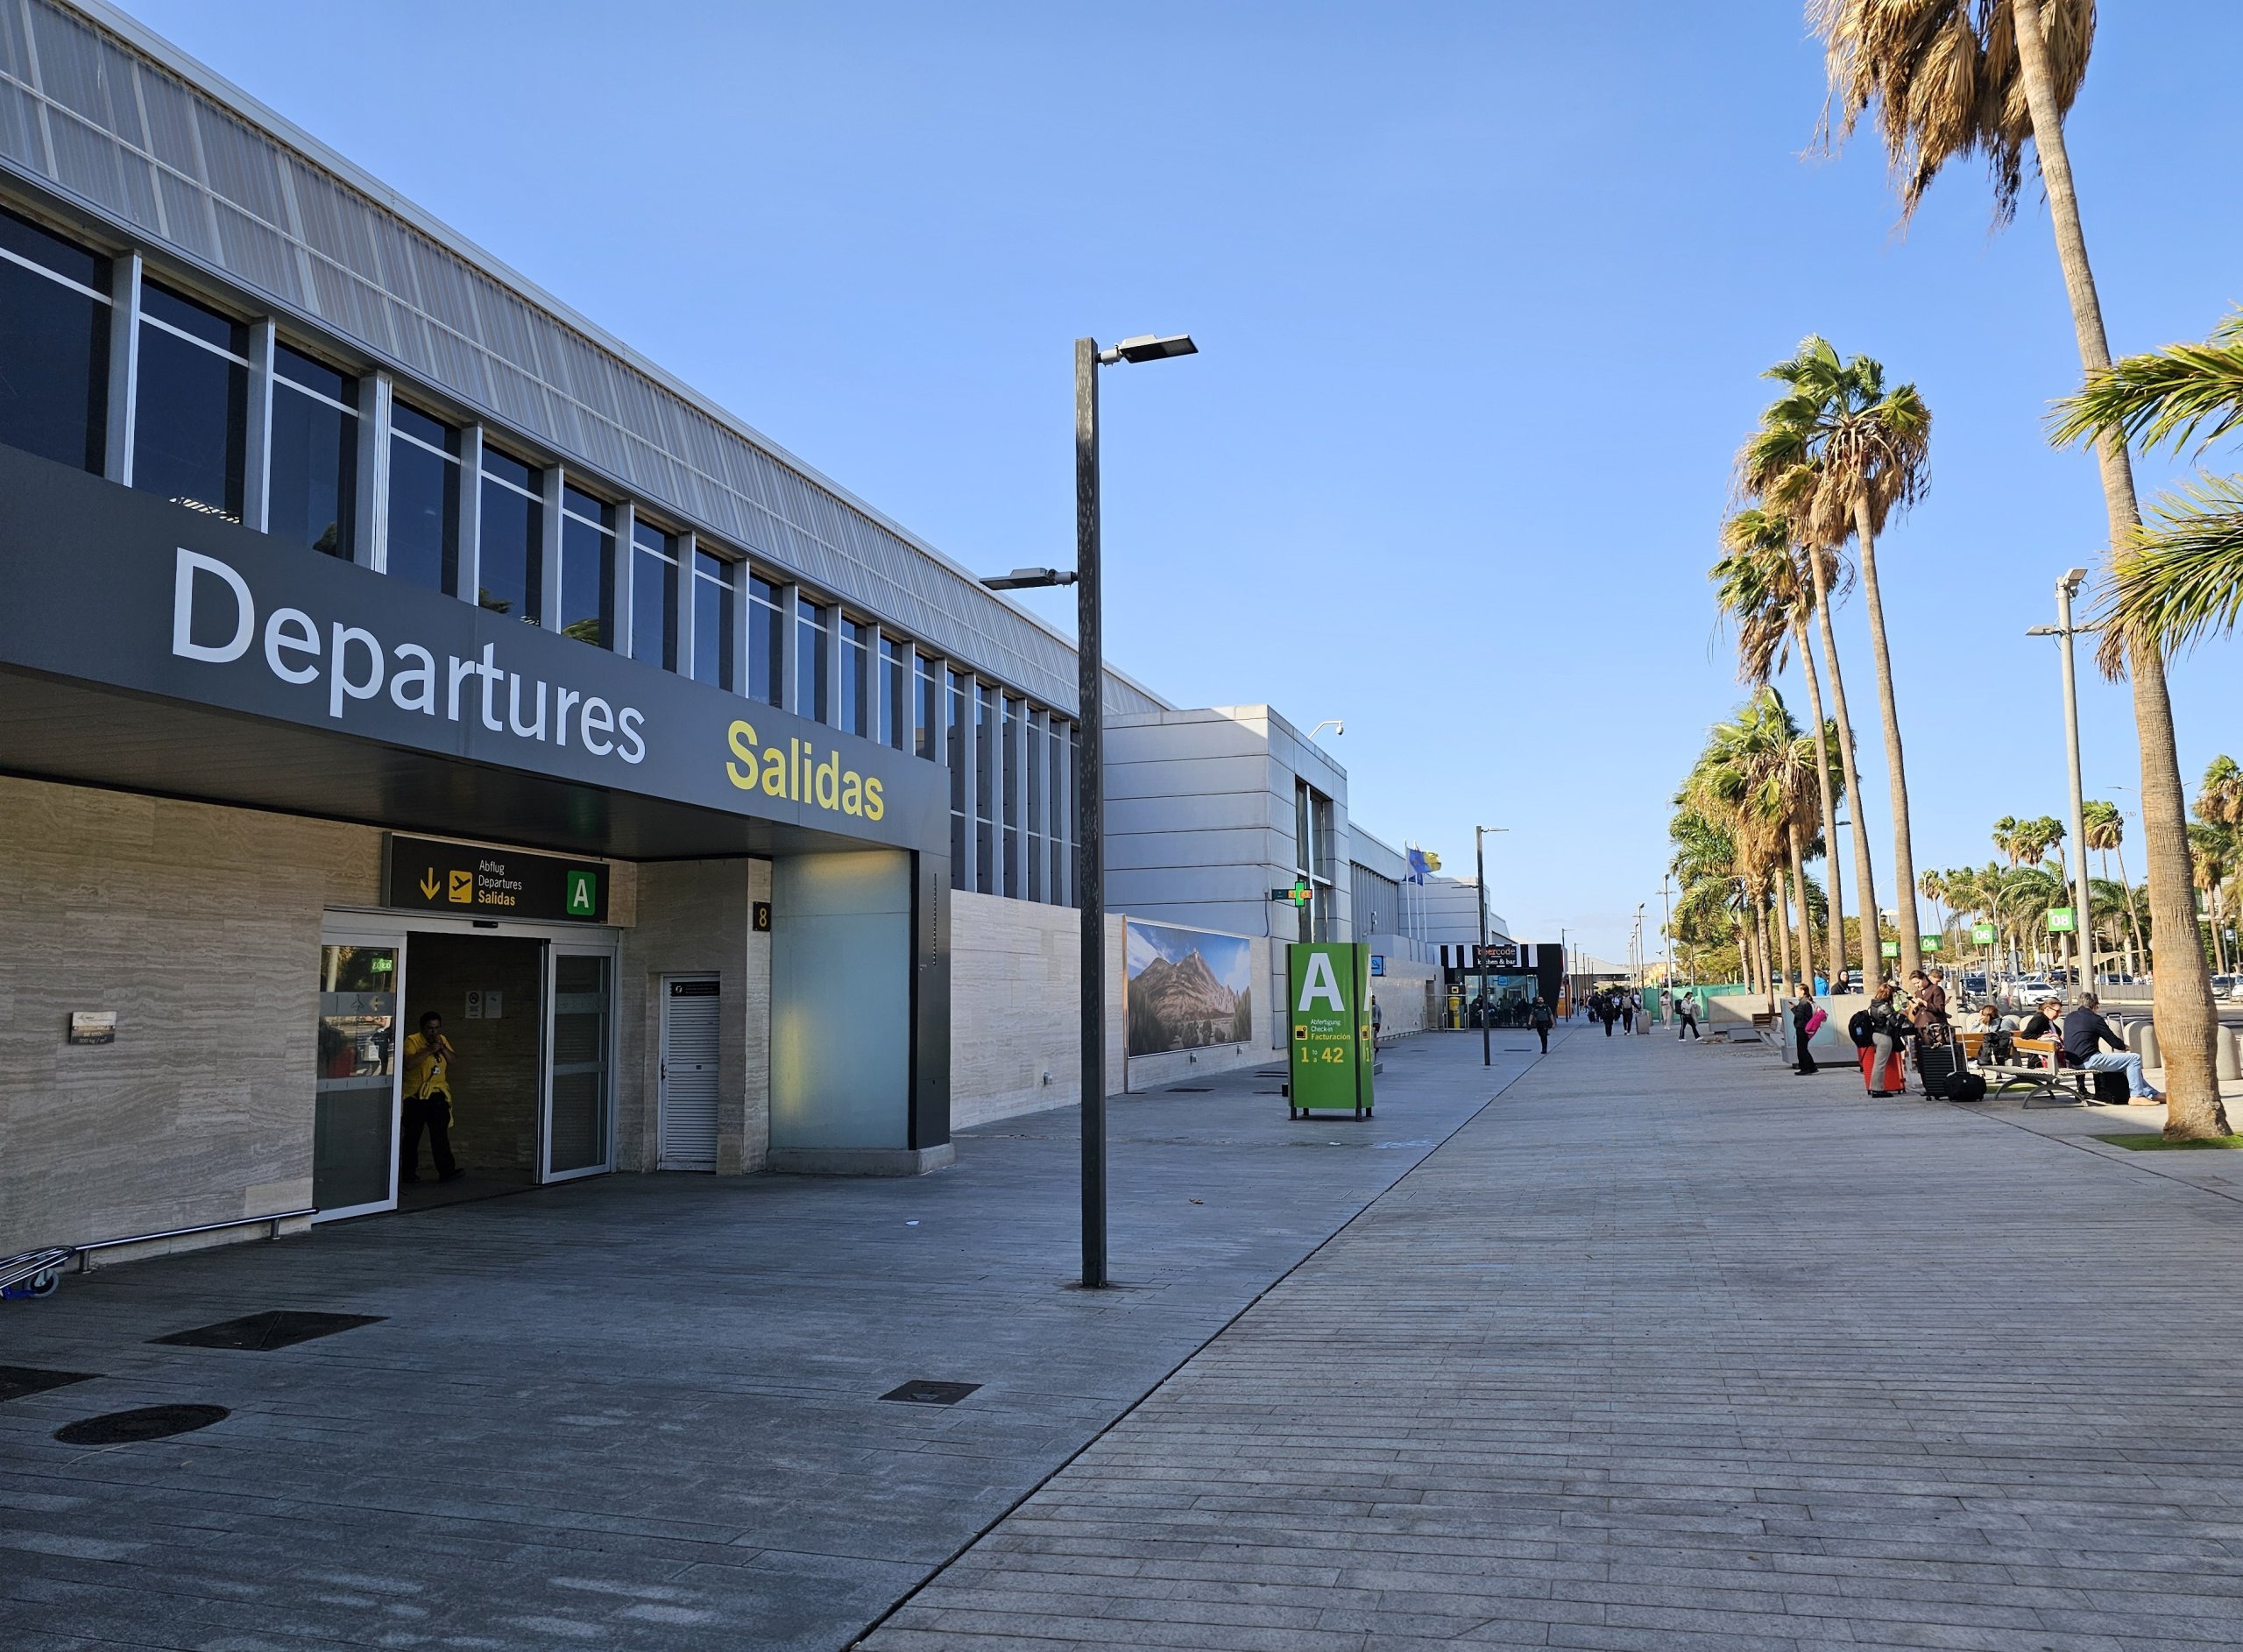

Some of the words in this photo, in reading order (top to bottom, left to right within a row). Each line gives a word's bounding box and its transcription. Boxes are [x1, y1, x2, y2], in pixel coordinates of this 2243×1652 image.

[172, 547, 647, 765] Departures
[725, 719, 884, 822] Salidas
[478, 859, 505, 875] Abflug
[478, 875, 522, 891] Departures
[478, 889, 516, 907] Salidas
[573, 879, 590, 908] A
[759, 907, 768, 928] 8
[2051, 914, 2070, 927] 08
[1976, 929, 1991, 940] 06
[1884, 945, 1895, 954] 02
[1922, 938, 1935, 948] 04
[1477, 947, 1516, 956] bercode
[1298, 952, 1346, 1012] A
[1301, 1047, 1309, 1063] 1
[1321, 1047, 1344, 1063] 42
